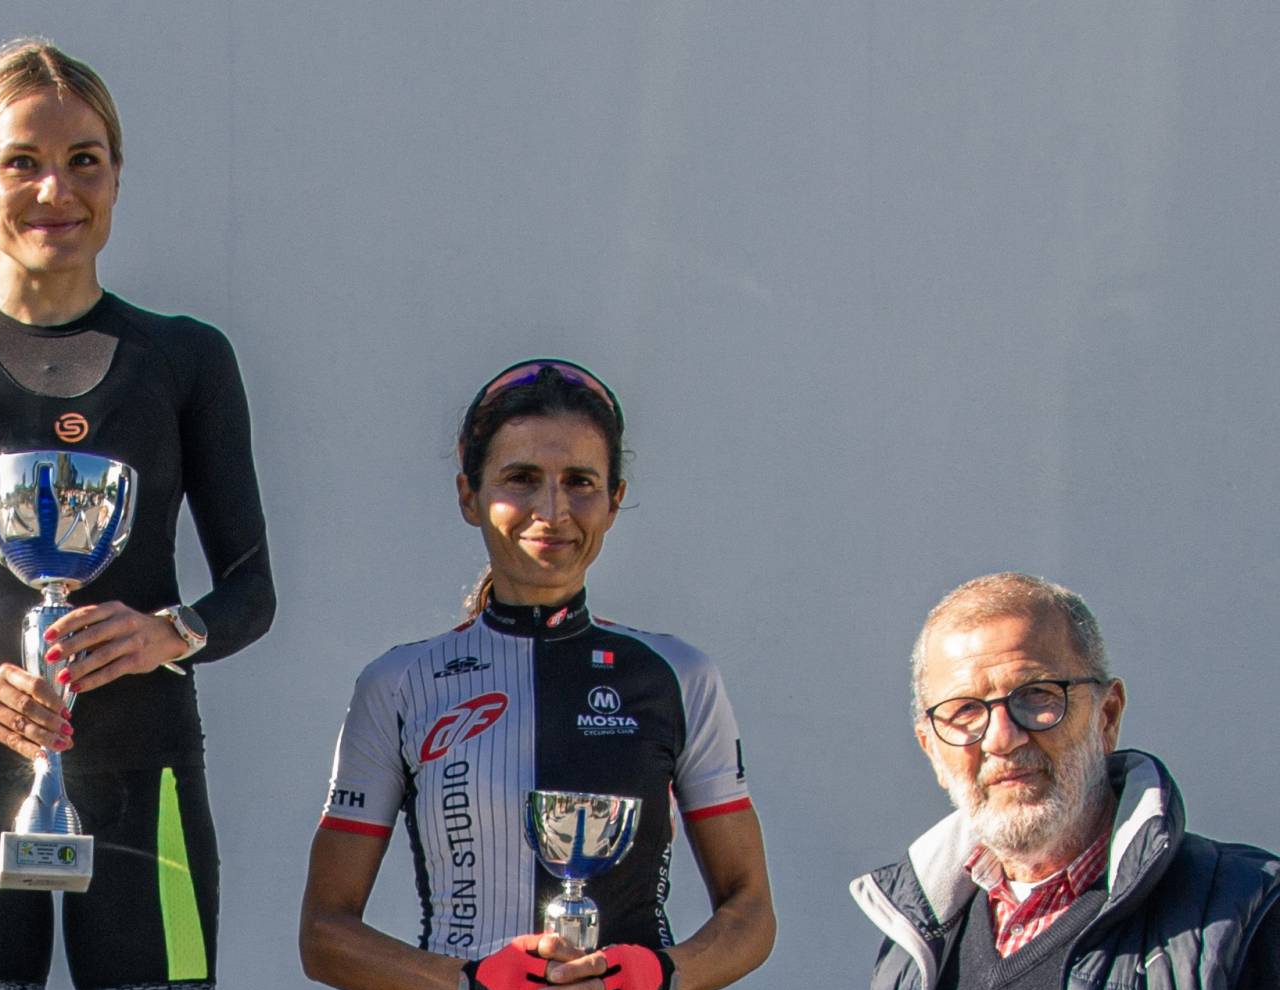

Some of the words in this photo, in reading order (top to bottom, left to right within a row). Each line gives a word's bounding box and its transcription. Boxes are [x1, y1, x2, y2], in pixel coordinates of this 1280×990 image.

[577, 714, 639, 727] MOSTA
[442, 760, 475, 868] STUDIO
[656, 866, 669, 904] SIGN
[447, 879, 478, 947] SIGN
